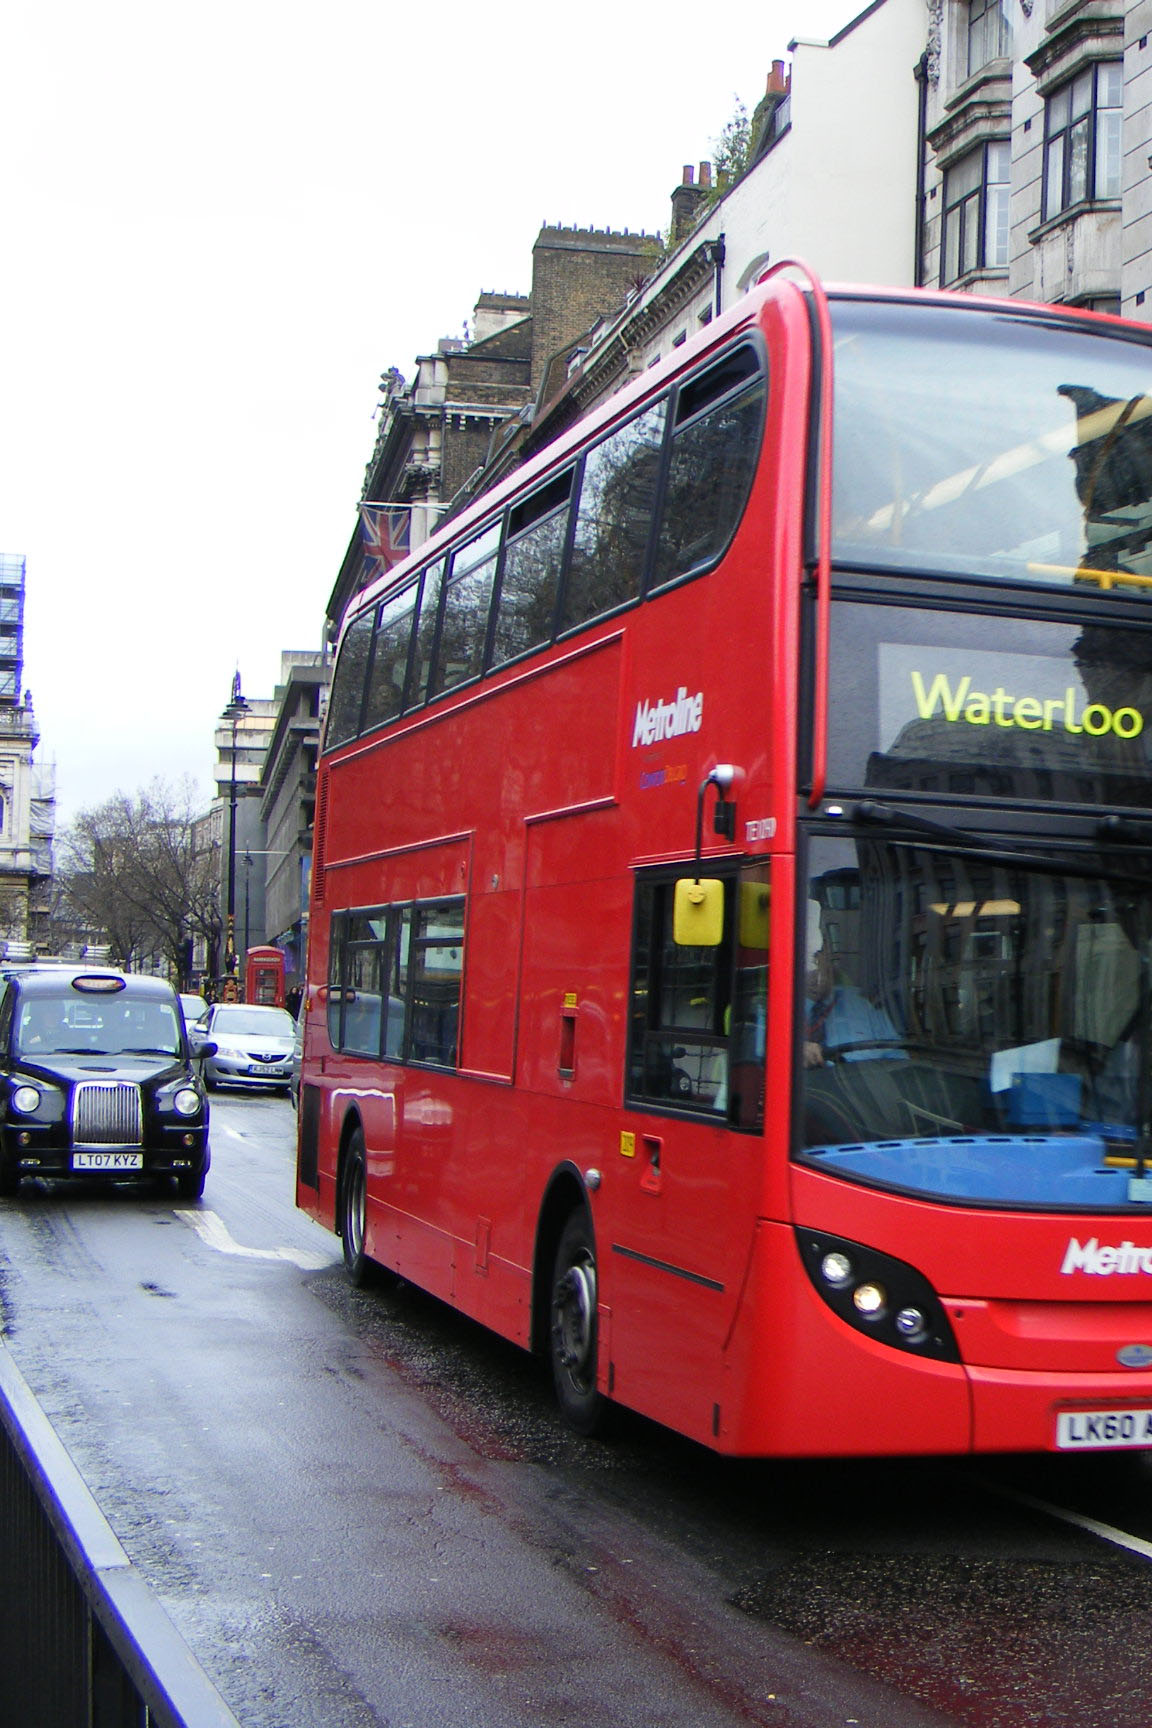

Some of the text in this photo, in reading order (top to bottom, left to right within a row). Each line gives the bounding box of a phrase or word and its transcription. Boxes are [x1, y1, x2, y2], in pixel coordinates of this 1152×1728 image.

[631, 686, 704, 748] Metroline
[910, 670, 1144, 739] Waterloo
[78, 1154, 138, 1166] LT07 KYZ
[1067, 1414, 1135, 1443] LK60
